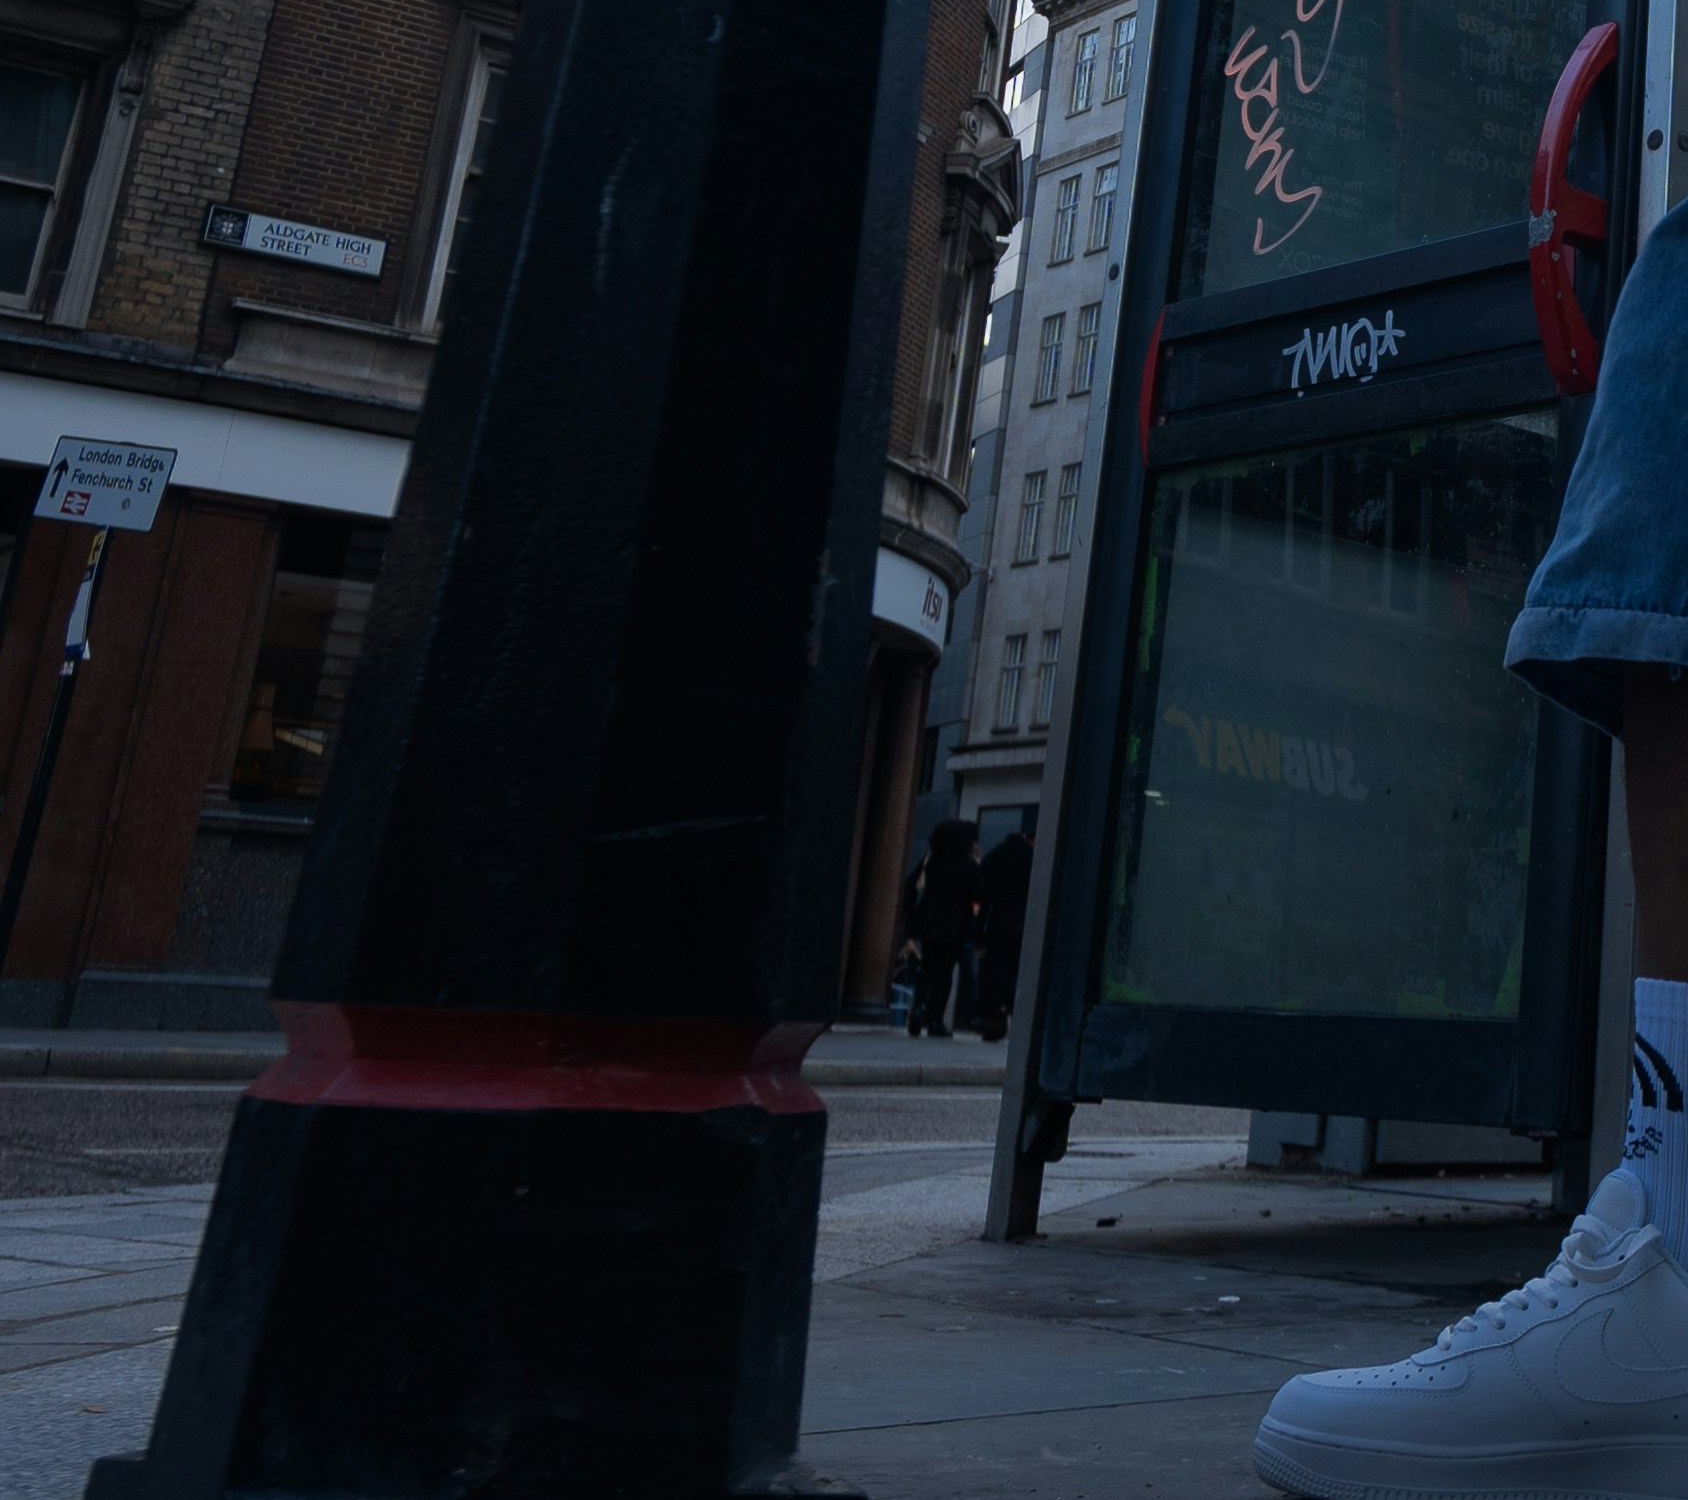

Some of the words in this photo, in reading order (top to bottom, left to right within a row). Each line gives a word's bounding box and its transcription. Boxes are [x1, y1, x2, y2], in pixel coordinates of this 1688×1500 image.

[260, 236, 313, 257] STREET
[342, 253, 370, 268] EC3
[264, 222, 331, 247] ALDGATE
[335, 236, 373, 255] HIGH
[79, 445, 123, 466] London
[71, 468, 134, 491] Fenchurch
[138, 476, 154, 494] St
[922, 577, 943, 623] itsu
